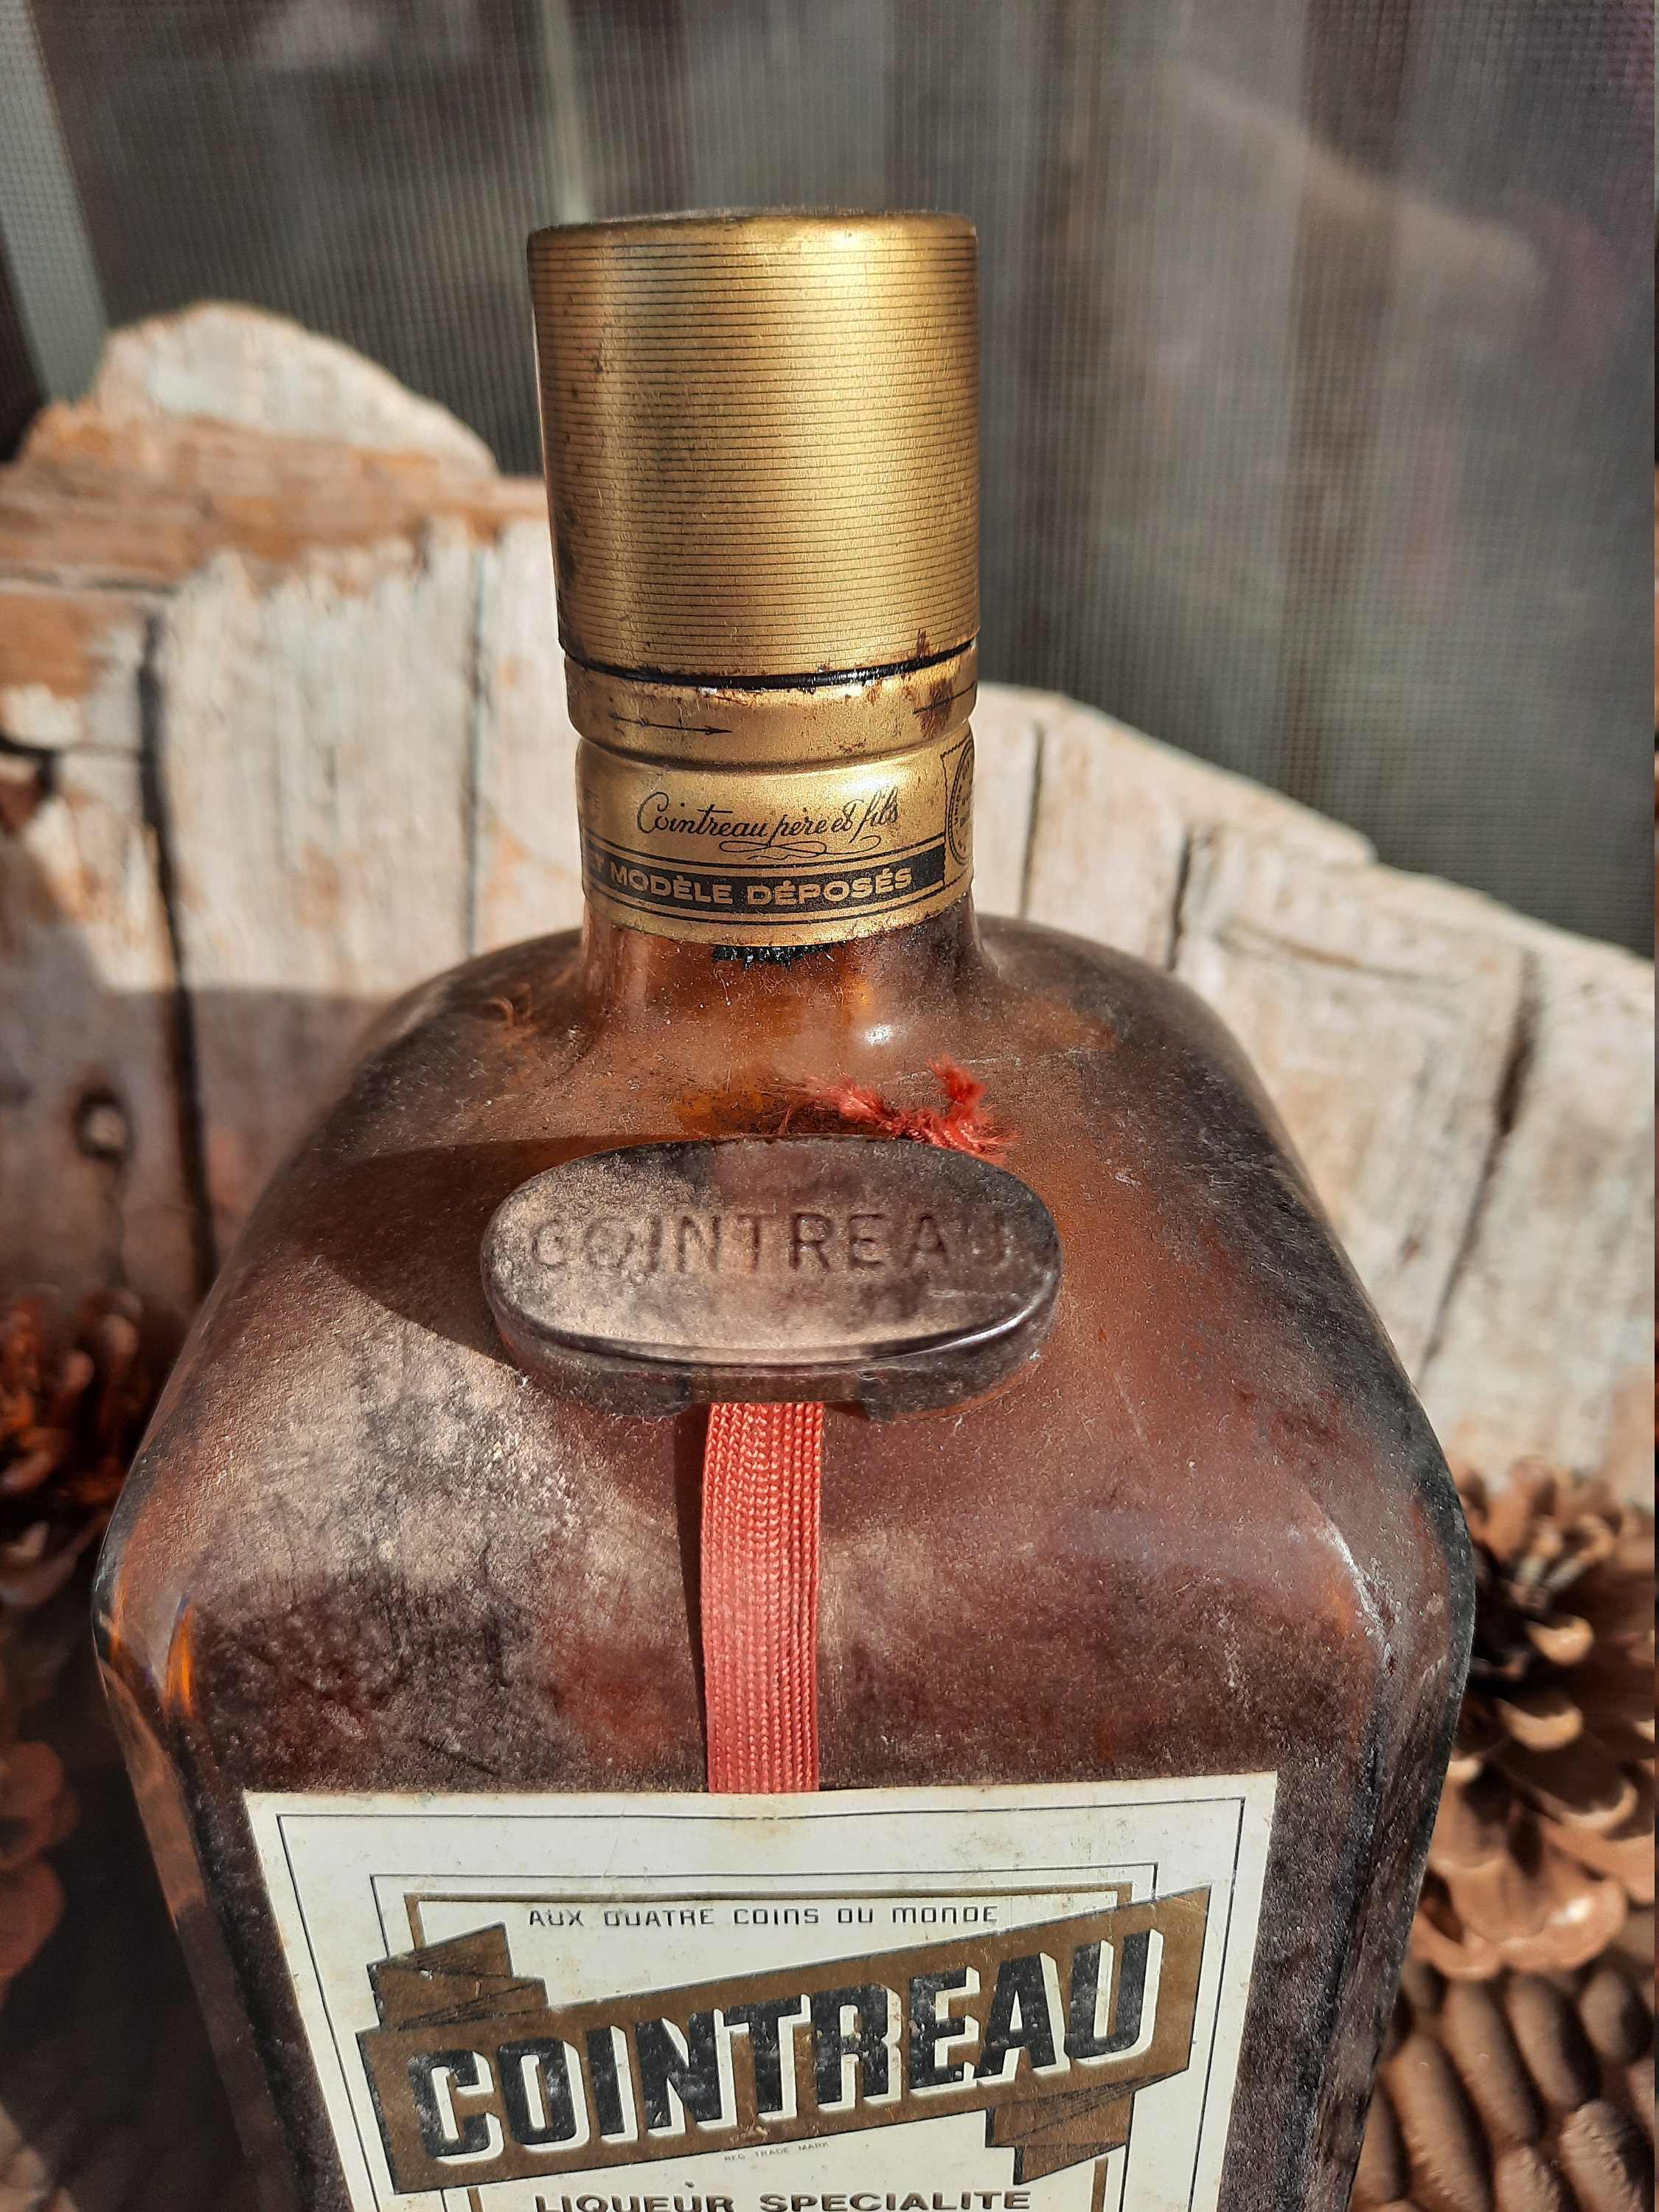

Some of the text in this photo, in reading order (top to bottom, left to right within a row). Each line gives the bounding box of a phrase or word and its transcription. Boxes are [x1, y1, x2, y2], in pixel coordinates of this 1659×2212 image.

[636, 791, 768, 838] Cointreau
[849, 786, 899, 844] fils
[611, 861, 734, 905] MODÈLE
[748, 866, 913, 906] DÉPOSÉS
[529, 1211, 1010, 1274] COINTREAU
[529, 1910, 585, 1927] AUX
[734, 1907, 819, 1925] COINS
[406, 1926, 1164, 2166] COINTREAU
[755, 2146, 790, 2158] TRADE
[798, 2140, 830, 2152] MARK
[535, 2190, 1032, 2212] LIQUEUR SPECIALITE
